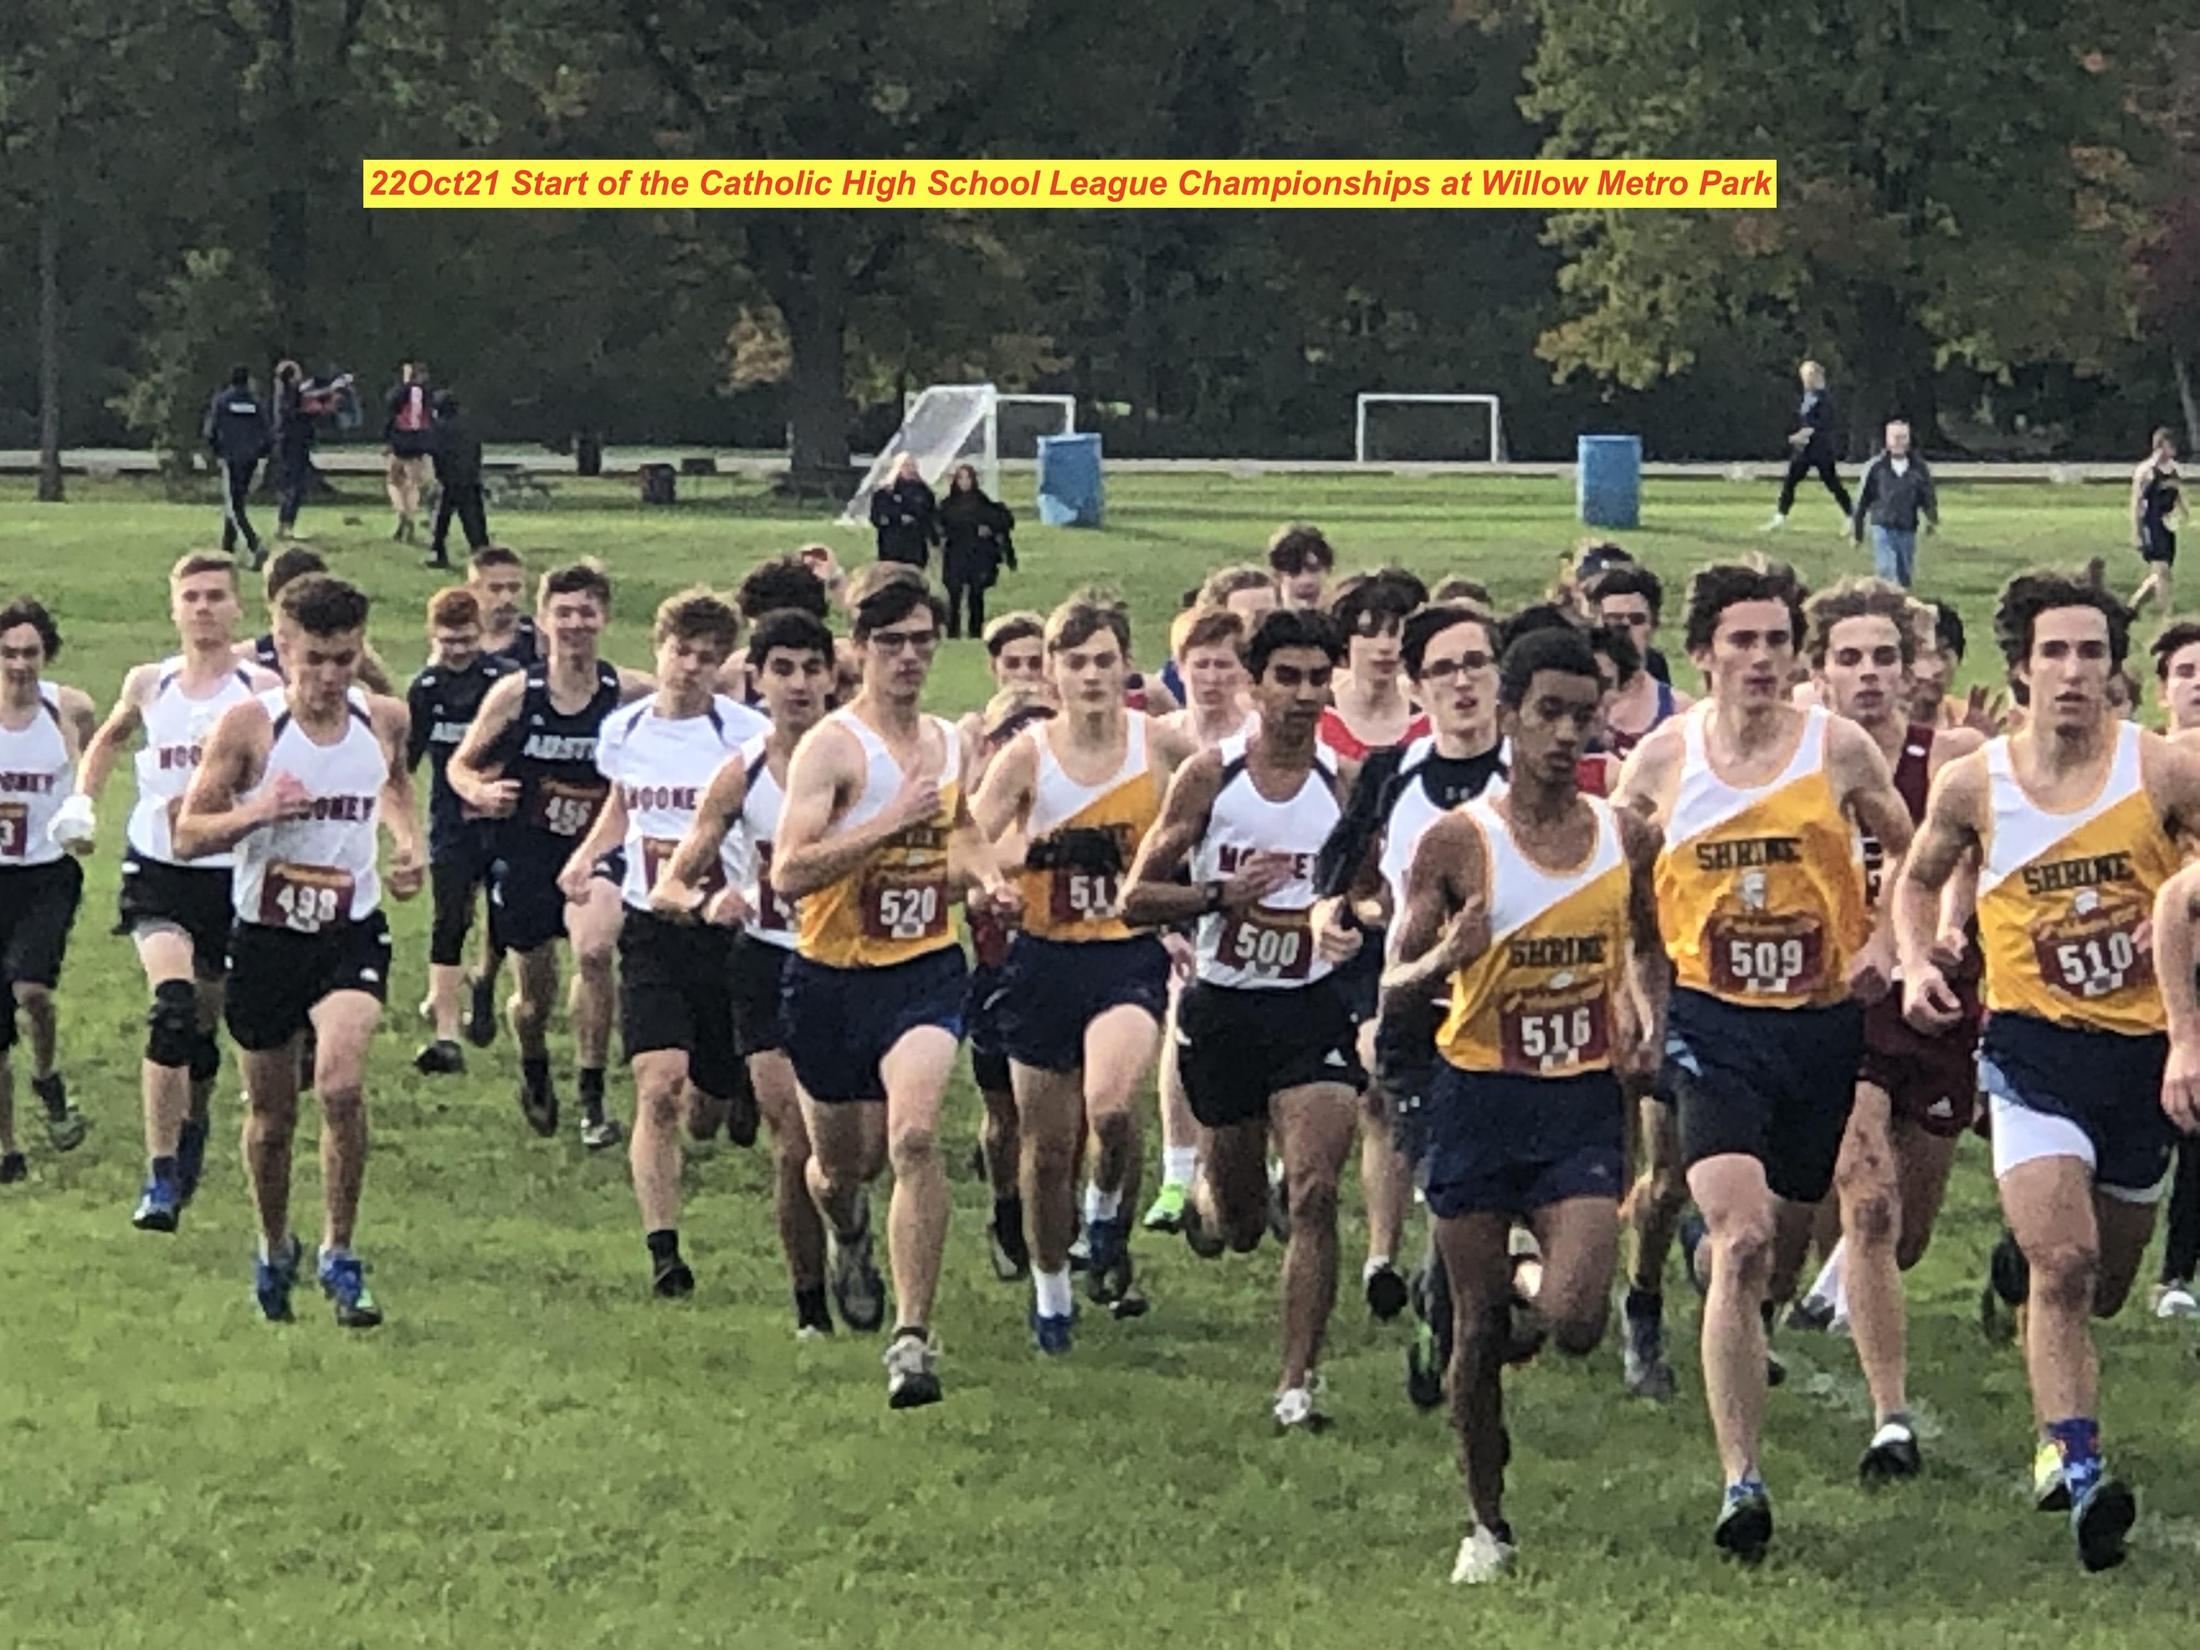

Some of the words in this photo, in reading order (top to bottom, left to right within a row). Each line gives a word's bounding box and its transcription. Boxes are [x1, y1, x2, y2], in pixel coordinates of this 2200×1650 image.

[1696, 837, 1802, 871] SHRINE
[2021, 850, 2135, 895] SHRINE
[880, 885, 937, 925] 520
[1234, 921, 1300, 967] 500
[1730, 939, 1803, 978] 509
[2057, 931, 2133, 985] 510
[1521, 1006, 1592, 1057] 516
